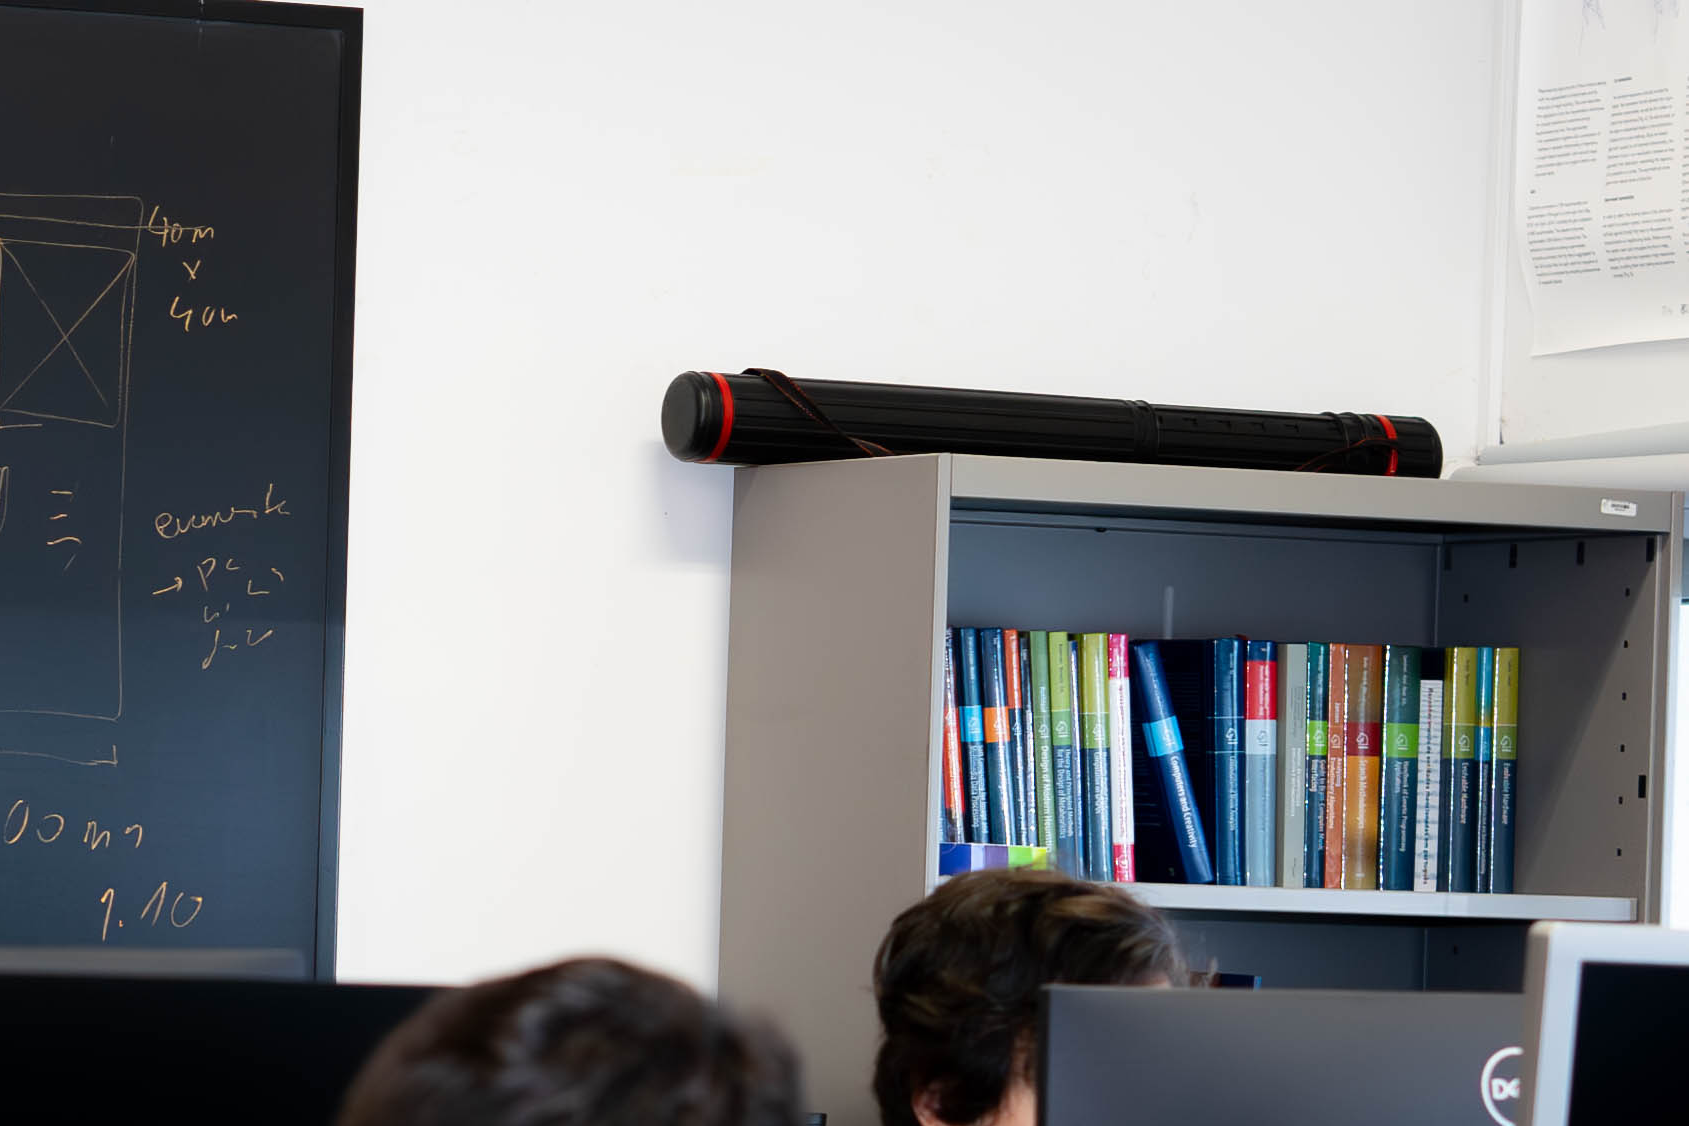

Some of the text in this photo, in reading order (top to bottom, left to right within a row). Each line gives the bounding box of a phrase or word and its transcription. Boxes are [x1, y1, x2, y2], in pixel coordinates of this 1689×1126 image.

[1040, 745, 1050, 773] Design
[1043, 783, 1052, 814] Modern
[1170, 756, 1198, 848] Computers and Creativity
